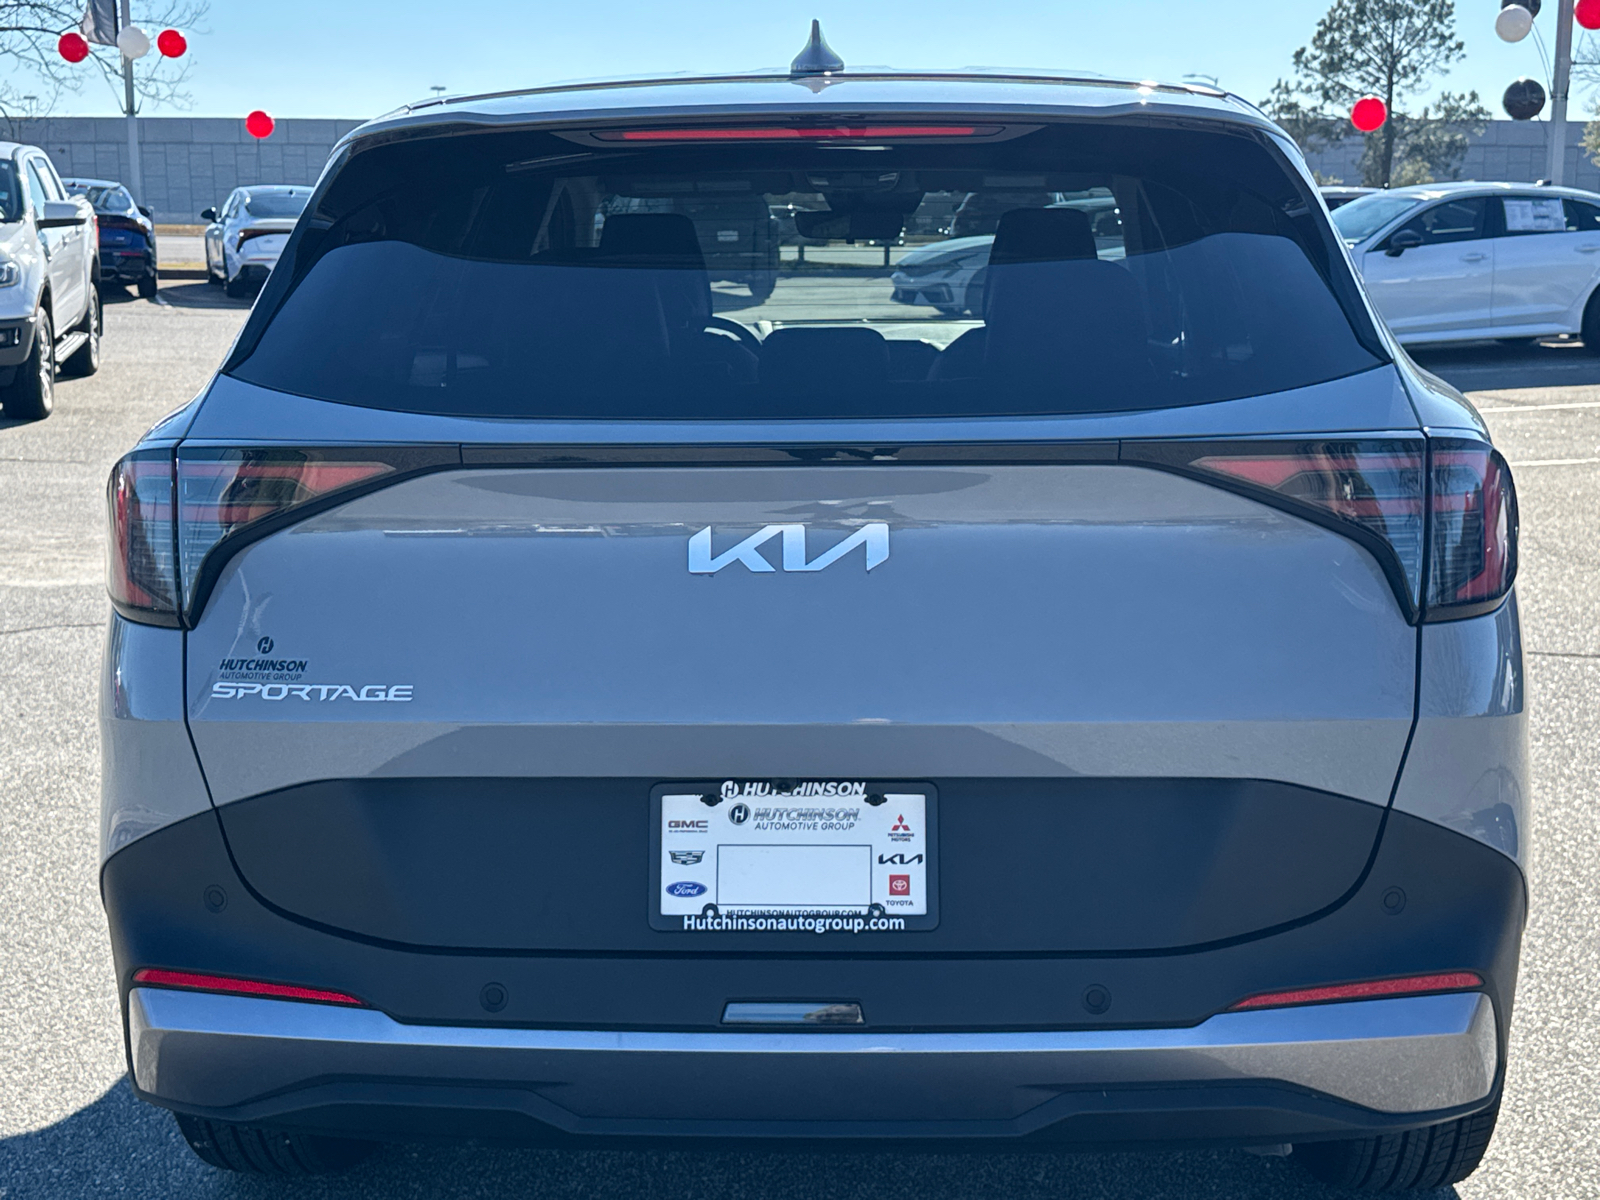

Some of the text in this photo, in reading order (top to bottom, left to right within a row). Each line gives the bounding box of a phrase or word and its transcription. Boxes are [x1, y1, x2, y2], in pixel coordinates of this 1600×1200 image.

[688, 523, 890, 573] KIA
[219, 659, 308, 672] HUTCHINSON
[219, 672, 303, 681] AUTOMOTIVE GROUP
[211, 682, 414, 701] SPORTAGE
[743, 781, 866, 797] HUHINSON
[753, 807, 860, 821] HUTCHINSON
[668, 820, 708, 828] GMC
[754, 822, 855, 831] AUTOMOTIVE GROUP
[878, 853, 923, 865] KIA
[673, 883, 700, 895] Ford
[683, 915, 905, 933] Hutchinsonautogroup.com
